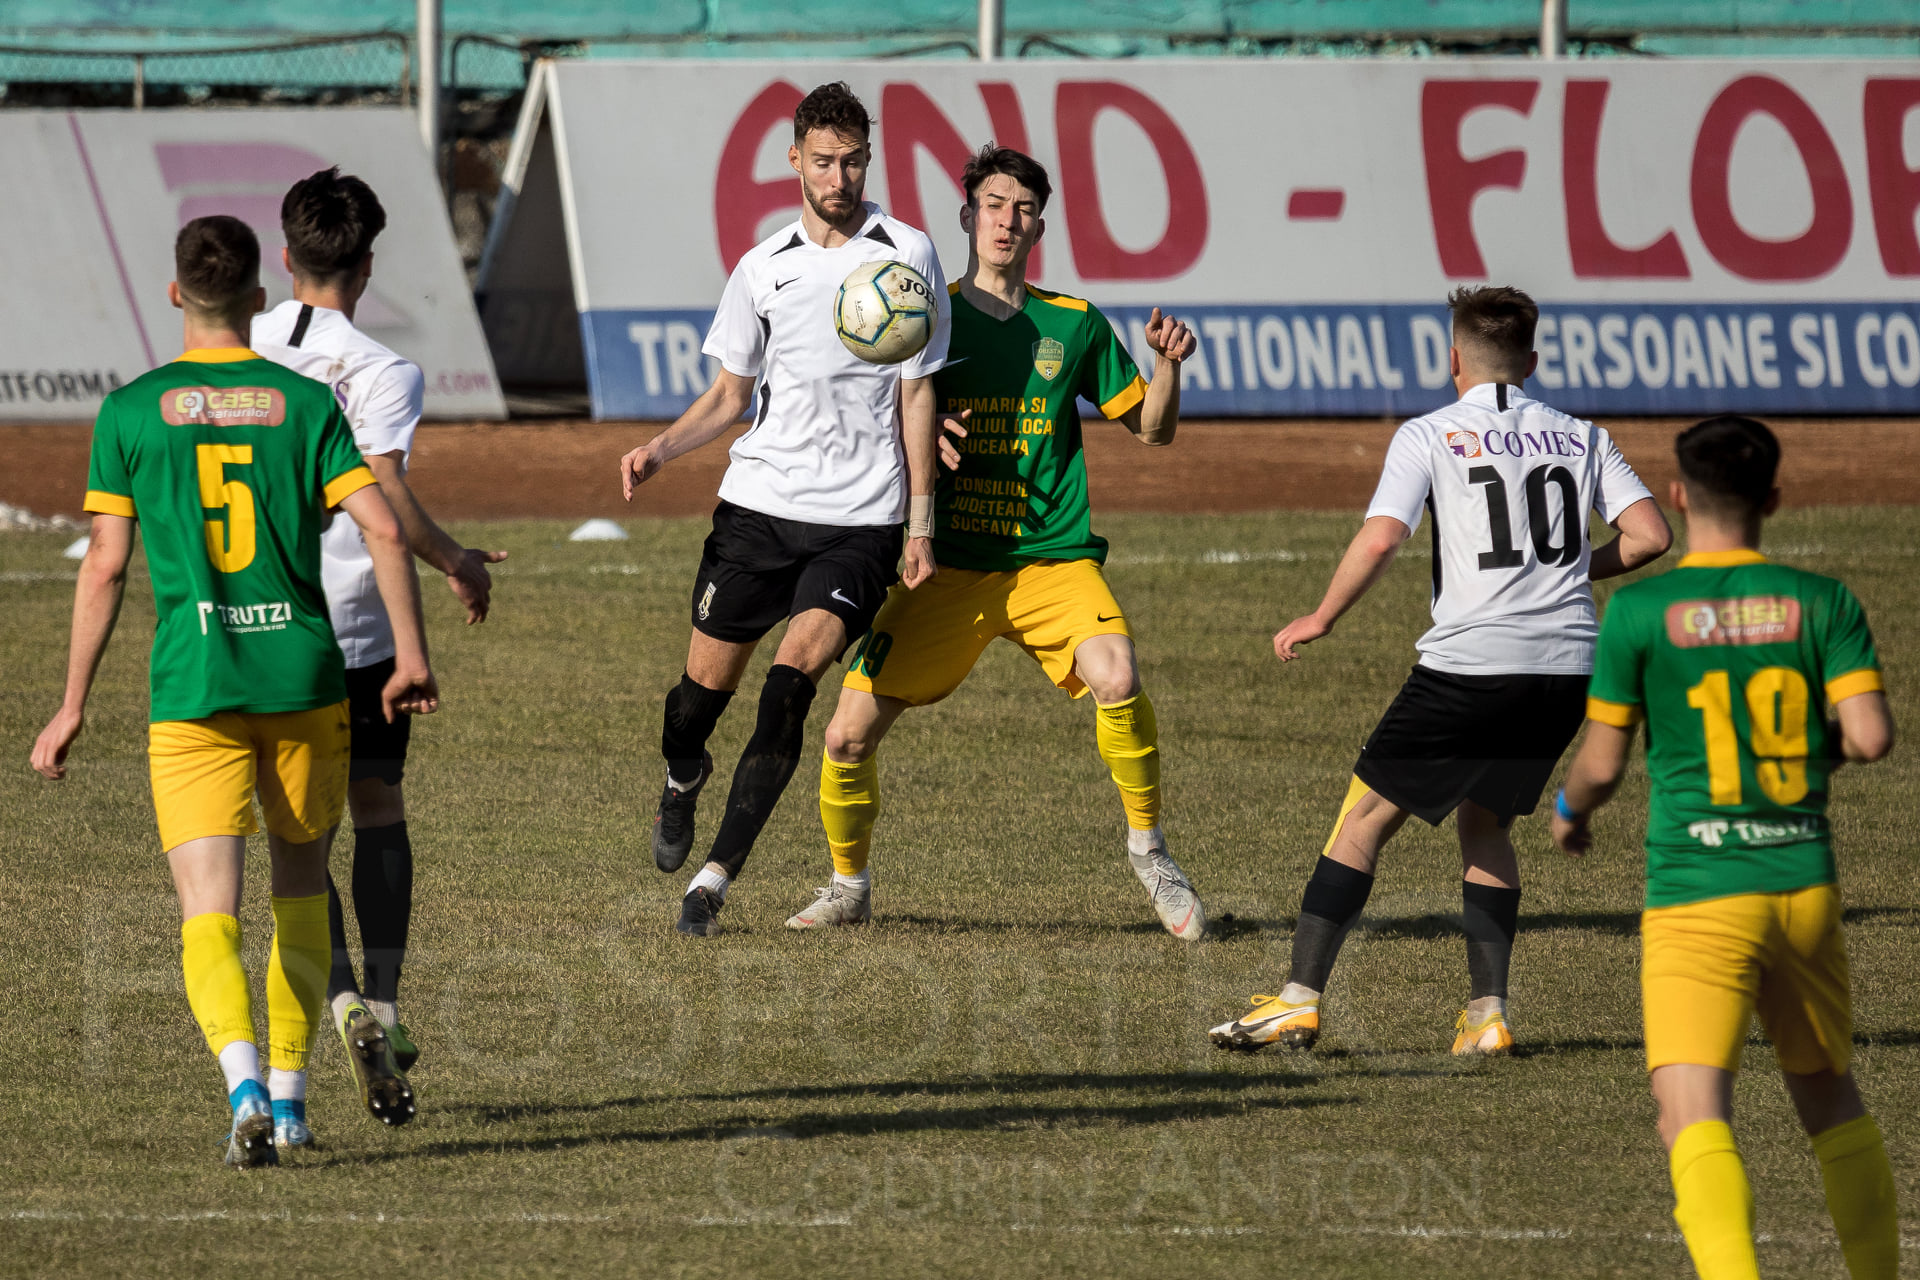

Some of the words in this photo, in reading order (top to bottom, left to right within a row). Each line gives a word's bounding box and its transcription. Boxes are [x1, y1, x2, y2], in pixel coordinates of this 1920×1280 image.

[1534, 312, 1781, 390] ERSOANE
[1789, 312, 1845, 390] SI
[947, 397, 1026, 413] PRIMARIA
[1031, 397, 1047, 414] SI
[958, 438, 1029, 456] SUCEAVA
[1484, 429, 1586, 458] COMES
[955, 476, 1028, 498] CONSILIUL
[196, 444, 256, 573] 5
[949, 496, 1027, 518] JUDETEAN
[1468, 463, 1582, 571] 10
[950, 514, 1022, 537] SUCEAVA
[217, 602, 292, 625] TRUTZI
[1686, 666, 1809, 806] 19
